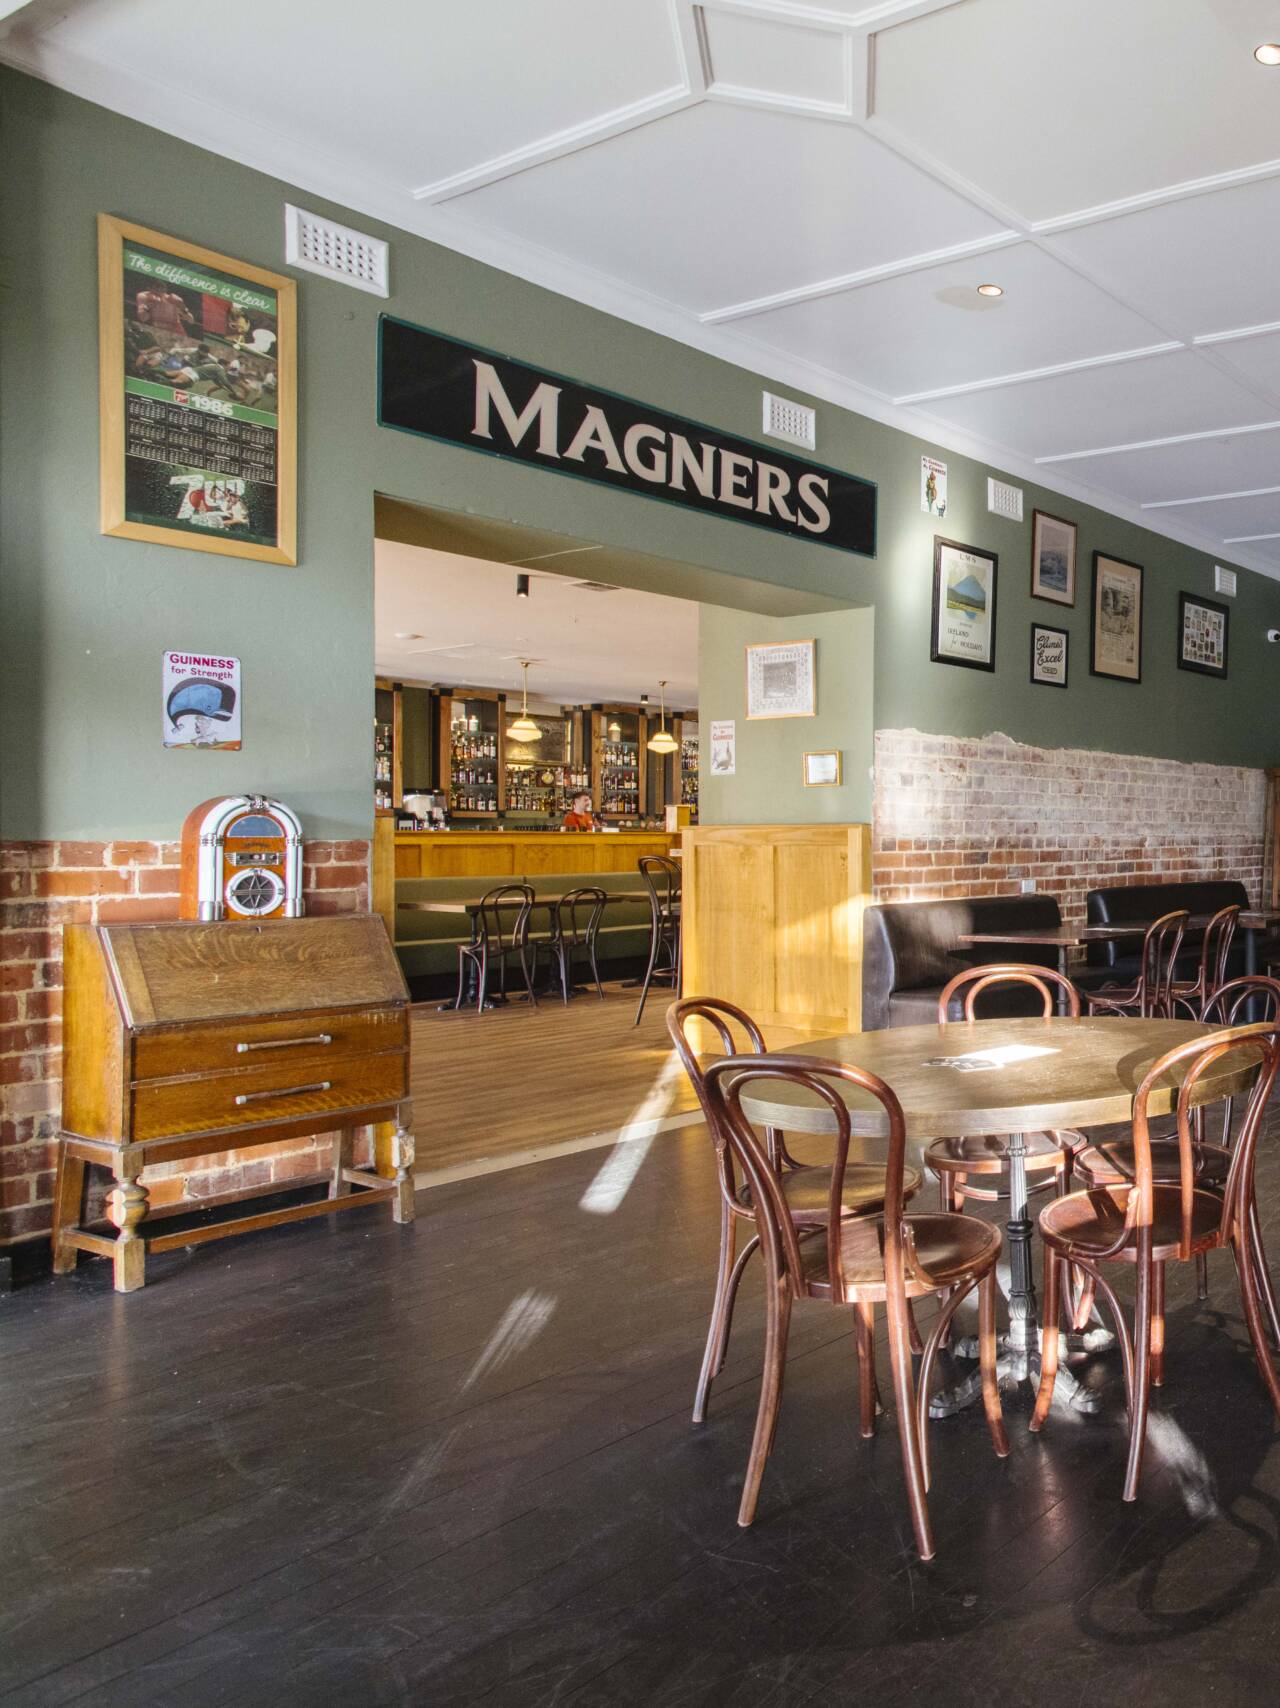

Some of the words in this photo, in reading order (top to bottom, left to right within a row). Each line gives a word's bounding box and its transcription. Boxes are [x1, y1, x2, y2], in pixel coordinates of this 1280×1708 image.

[129, 254, 152, 272] The
[154, 264, 218, 294] difference
[220, 285, 231, 297] is
[233, 289, 271, 310] clear
[191, 395, 234, 416] 1986
[469, 358, 831, 534] MAGNERS
[169, 653, 234, 669] GUINNESS
[171, 666, 187, 674] for
[190, 667, 233, 680] Strength
